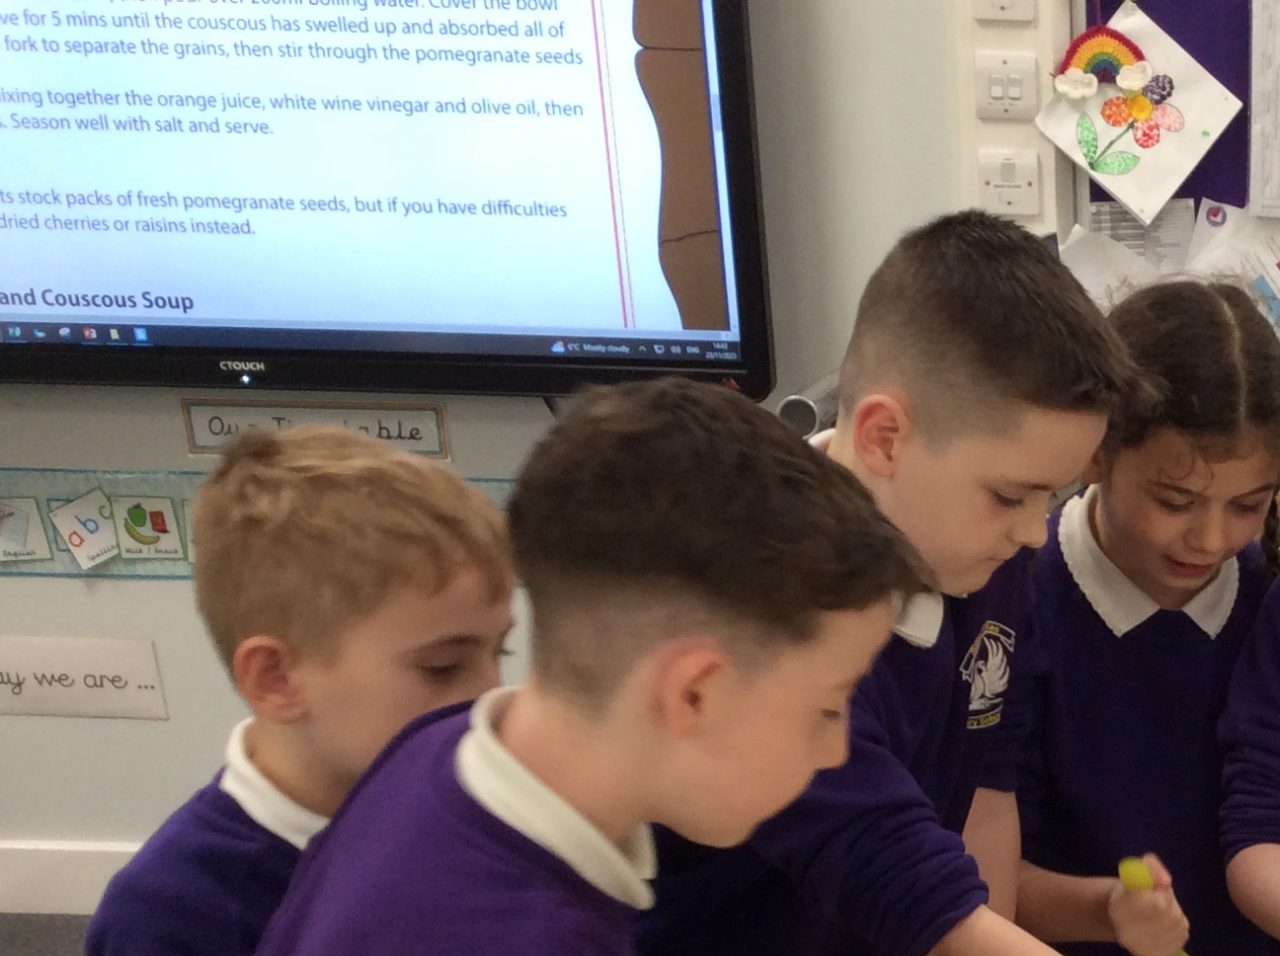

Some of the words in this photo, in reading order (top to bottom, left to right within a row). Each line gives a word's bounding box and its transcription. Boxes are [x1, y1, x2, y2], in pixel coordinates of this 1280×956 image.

[23, 8, 46, 26] for
[51, 10, 62, 27] 5
[66, 11, 108, 28] mins
[111, 11, 150, 29] until
[154, 12, 183, 30] the
[187, 17, 267, 32] couscous
[270, 14, 301, 33] has
[305, 16, 369, 34] swelled
[374, 22, 397, 38] up
[401, 18, 434, 36] and
[438, 18, 519, 37] absorbed
[524, 20, 543, 38] all
[548, 20, 565, 38] of
[4, 34, 39, 53] fork
[41, 37, 60, 53] to
[64, 39, 137, 57] separate
[141, 38, 169, 55] the
[173, 41, 230, 60] grains,
[233, 40, 274, 58] then
[277, 42, 303, 58] stir
[308, 42, 378, 64] through
[382, 44, 411, 62] the
[415, 47, 531, 67] pomegranate
[535, 48, 584, 65] seeds
[47, 88, 121, 109] together
[125, 90, 153, 107] the
[157, 94, 217, 112] orange
[220, 94, 266, 112] juice,
[269, 94, 317, 110] white
[321, 96, 363, 112] wine
[366, 97, 430, 117] vinegar
[434, 97, 467, 115] and
[471, 98, 512, 116] olive
[515, 99, 541, 118] oil,
[545, 100, 585, 117] then
[10, 112, 72, 131] Season
[74, 113, 110, 132] well
[113, 114, 151, 133] with
[155, 116, 184, 134] salt
[188, 117, 221, 135] and
[224, 121, 274, 136] serve.
[18, 188, 62, 206] stock
[65, 190, 114, 209] packs
[116, 190, 134, 208] of
[136, 190, 180, 208] fresh
[183, 193, 296, 213] pomegranate
[299, 195, 351, 213] seeds,
[353, 196, 384, 213] but
[387, 197, 398, 213] if
[402, 200, 434, 217] you
[436, 198, 478, 216] have
[481, 199, 568, 218] difficulties
[0, 213, 41, 231] dried
[43, 214, 111, 232] cherries
[112, 218, 131, 232] or
[134, 216, 188, 234] raisins
[190, 218, 257, 236] instead.
[0, 287, 38, 307] and
[40, 288, 138, 309] Couscous
[141, 291, 195, 314] Soup
[218, 359, 266, 371] CTOUCH
[32, 672, 75, 688] we
[83, 674, 128, 689] are
